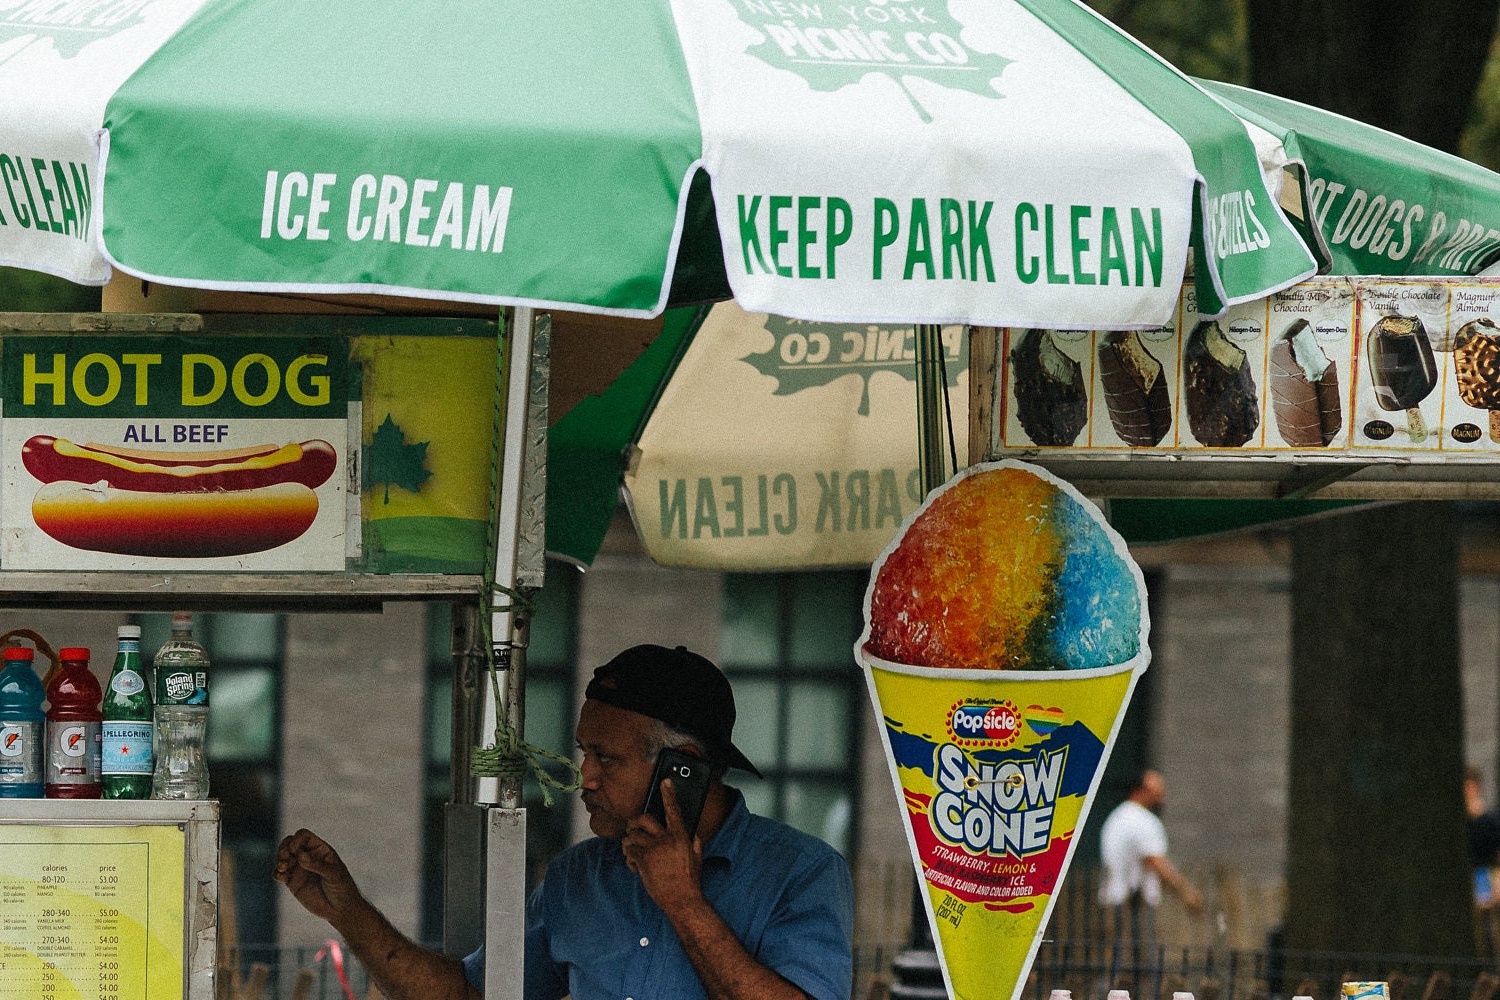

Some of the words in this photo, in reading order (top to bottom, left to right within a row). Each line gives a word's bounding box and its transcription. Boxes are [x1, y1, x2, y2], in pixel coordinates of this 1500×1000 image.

[844, 5, 937, 24] YORK
[904, 31, 969, 64] CO
[261, 170, 338, 241] ICE
[347, 174, 514, 254] CREAM
[1331, 188, 1425, 261] DOGS
[736, 194, 854, 280] KEEP
[872, 198, 996, 283] PARK
[1015, 201, 1164, 288] CLEAN
[1401, 290, 1441, 301] Chocolate
[1273, 303, 1313, 313] Chocolate
[1369, 301, 1400, 311] Vanilla
[1455, 303, 1490, 313] Almond
[21, 352, 147, 407] HOT
[181, 352, 332, 407] DOG
[123, 425, 167, 444] ALL
[172, 424, 229, 444] BEEF
[165, 673, 194, 686] Poland
[166, 682, 195, 696] Spring
[953, 706, 1016, 732] Popsicle
[938, 743, 1065, 814] SNOW
[934, 790, 1055, 852] CONE
[992, 863, 1028, 875] LEMON
[1029, 863, 1037, 873] &
[923, 868, 954, 887] ARTIFICIAL
[954, 879, 977, 893] FLAVOR
[977, 885, 990, 896] AND
[990, 886, 1010, 897] COLOR
[1011, 886, 1034, 896] ADDED
[99, 973, 118, 981] $4.00
